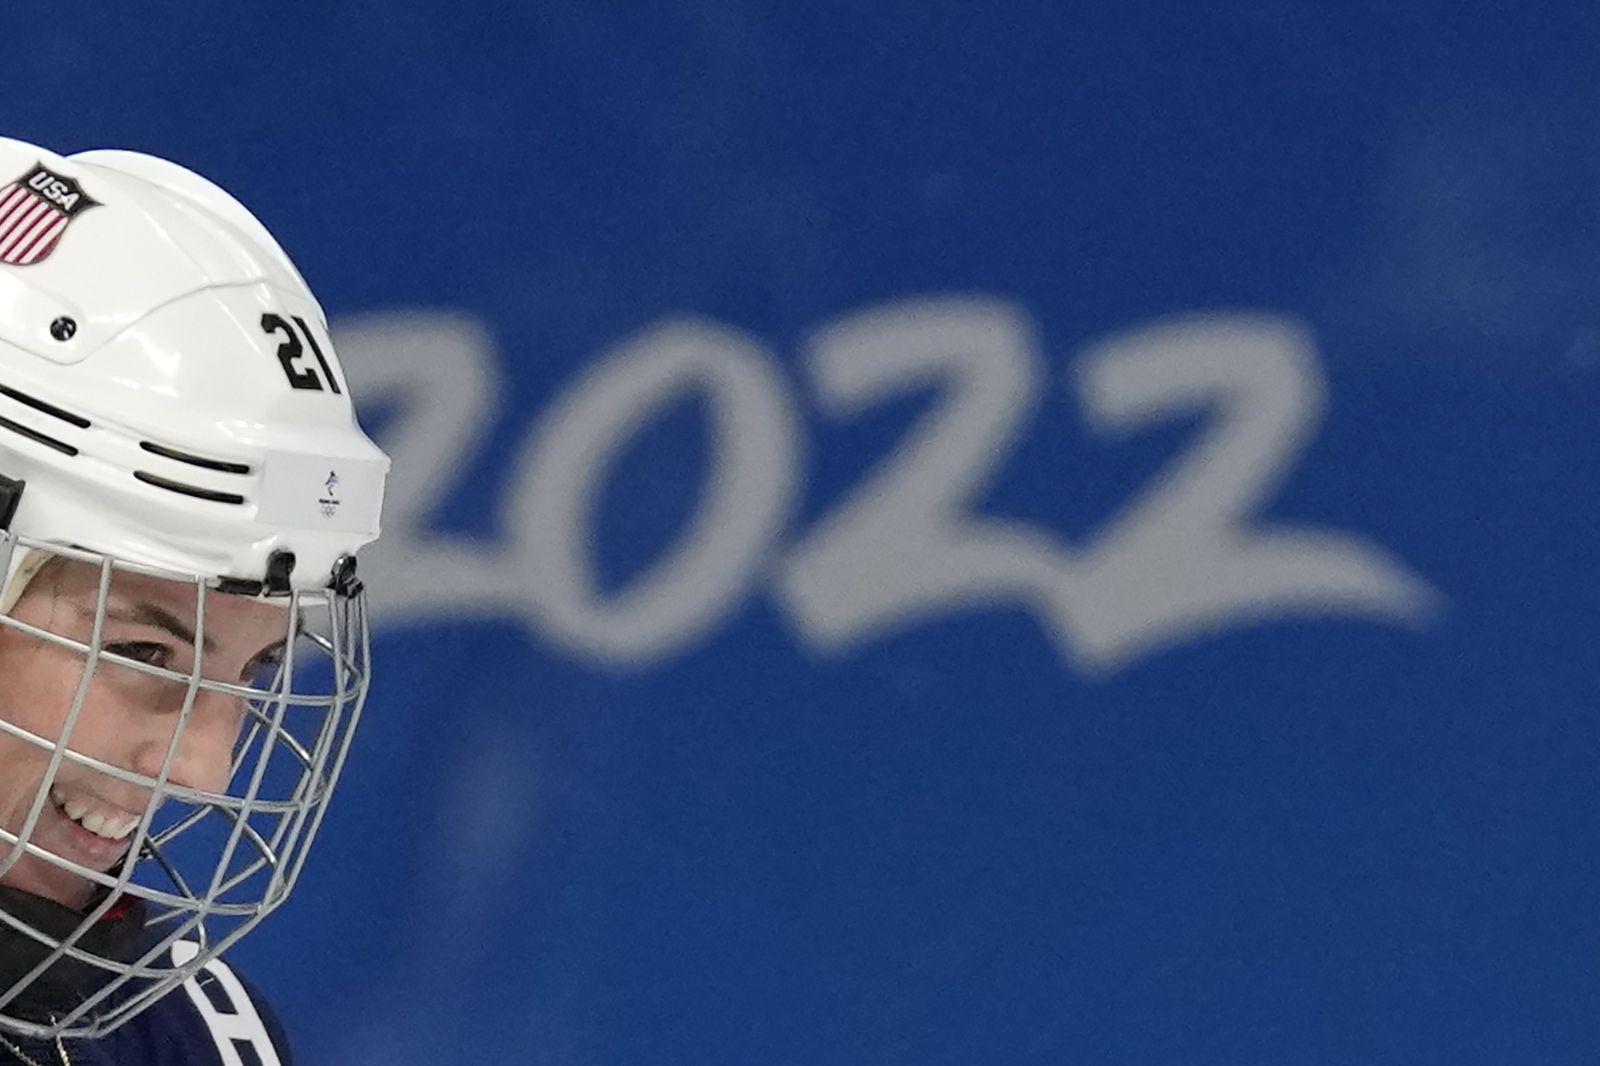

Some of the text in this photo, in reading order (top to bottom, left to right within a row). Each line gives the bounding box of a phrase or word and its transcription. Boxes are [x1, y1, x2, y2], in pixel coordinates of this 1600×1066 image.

[28, 171, 80, 211] USA
[260, 312, 343, 395] 21
[332, 292, 1445, 678] 2022
